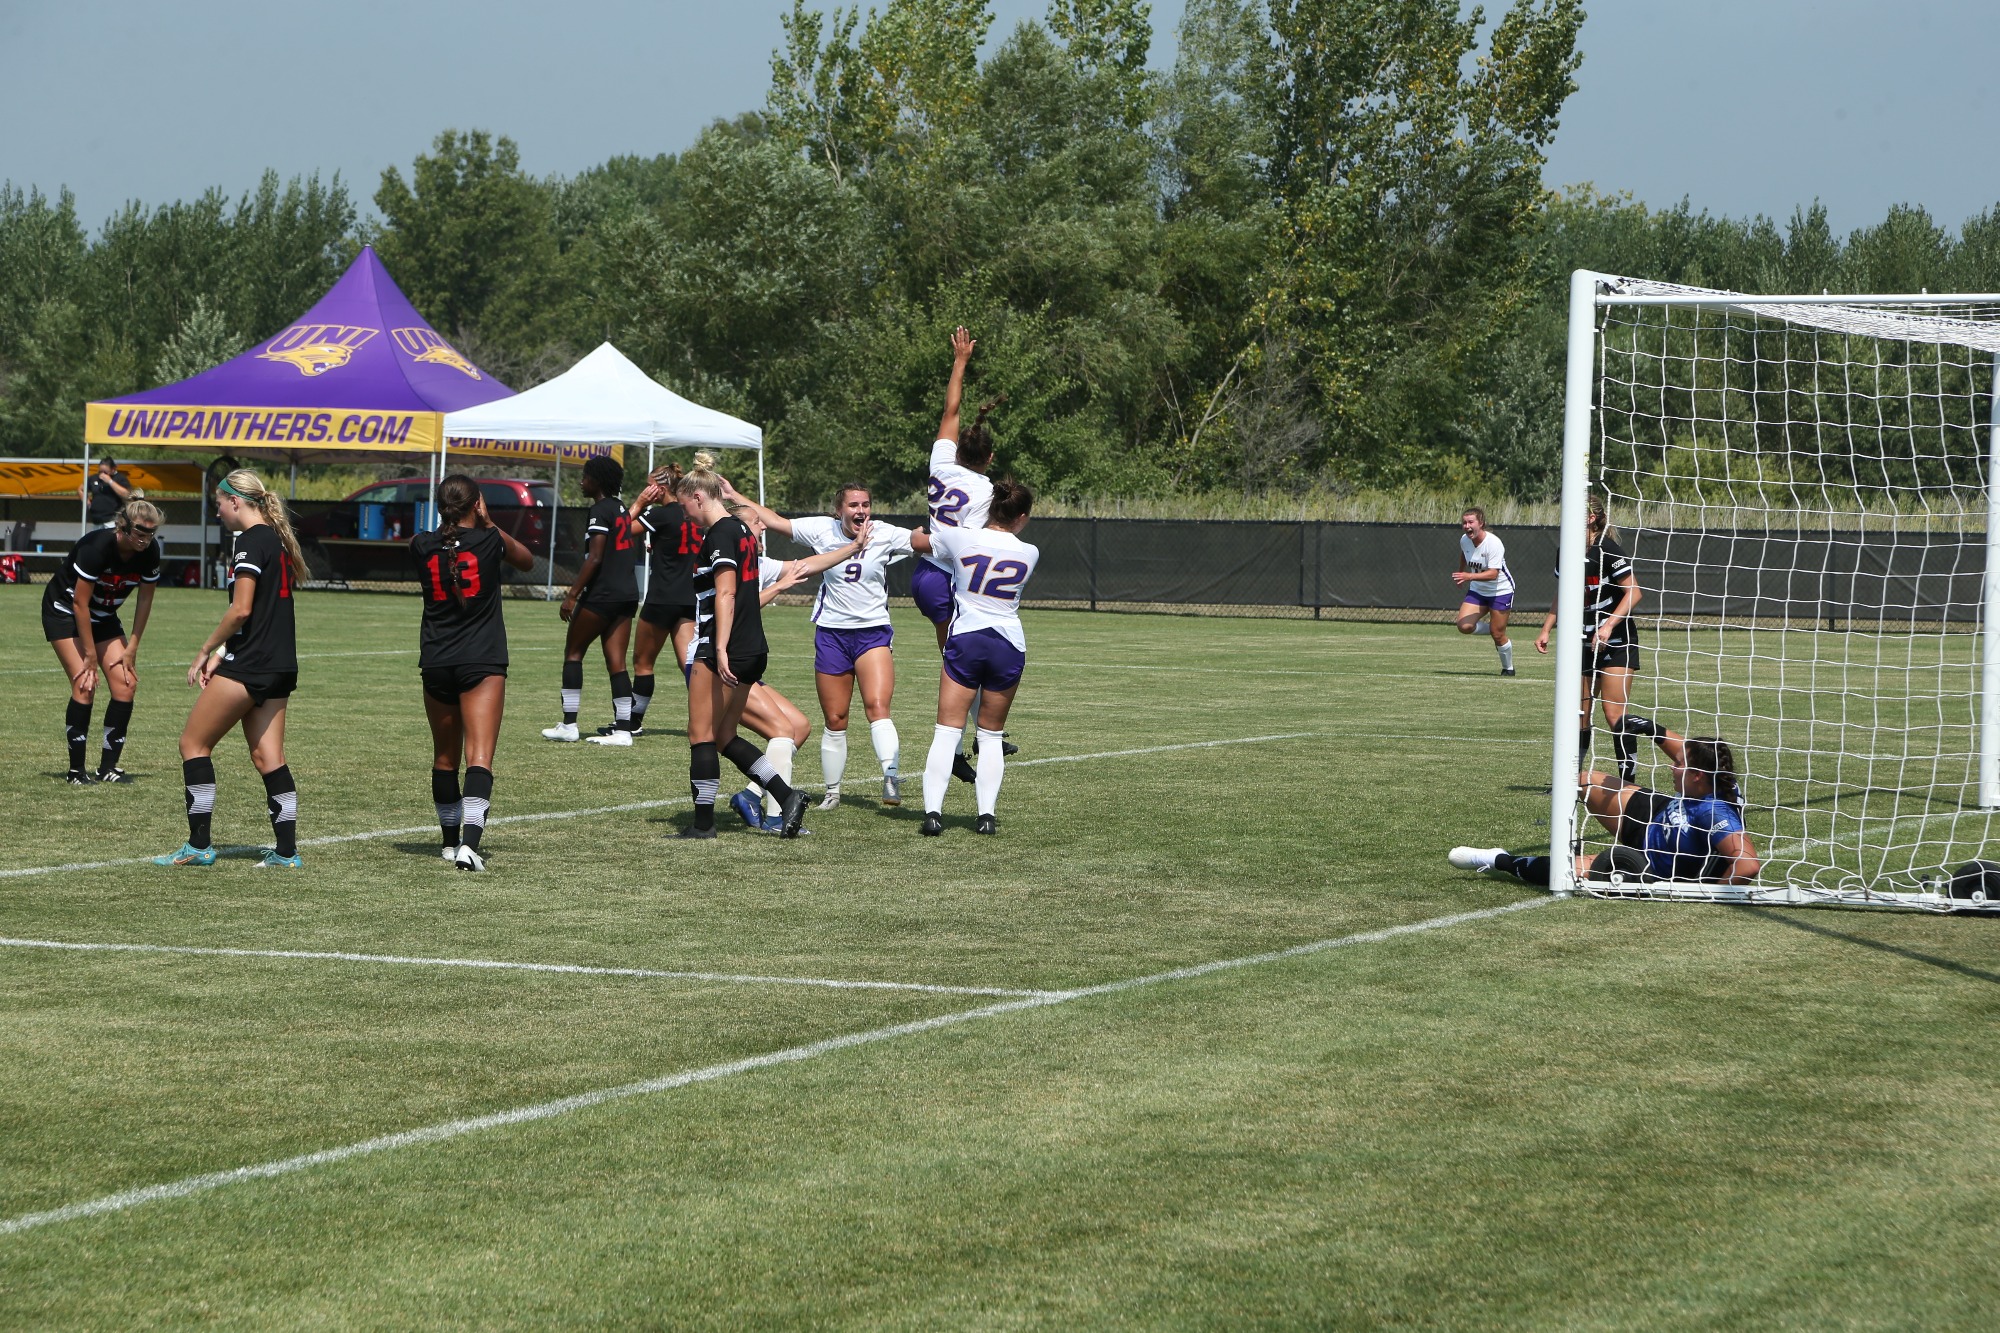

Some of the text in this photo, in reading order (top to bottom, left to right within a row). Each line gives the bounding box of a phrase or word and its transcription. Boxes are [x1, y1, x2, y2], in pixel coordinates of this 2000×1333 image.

[266, 324, 380, 354] UNI
[391, 328, 452, 357] UN
[107, 409, 414, 445] UNIPANTHERS.COM
[928, 476, 970, 527] 22
[615, 515, 635, 551] 2
[427, 551, 481, 601] 13
[844, 562, 862, 583] 9
[960, 554, 1029, 601] 12
